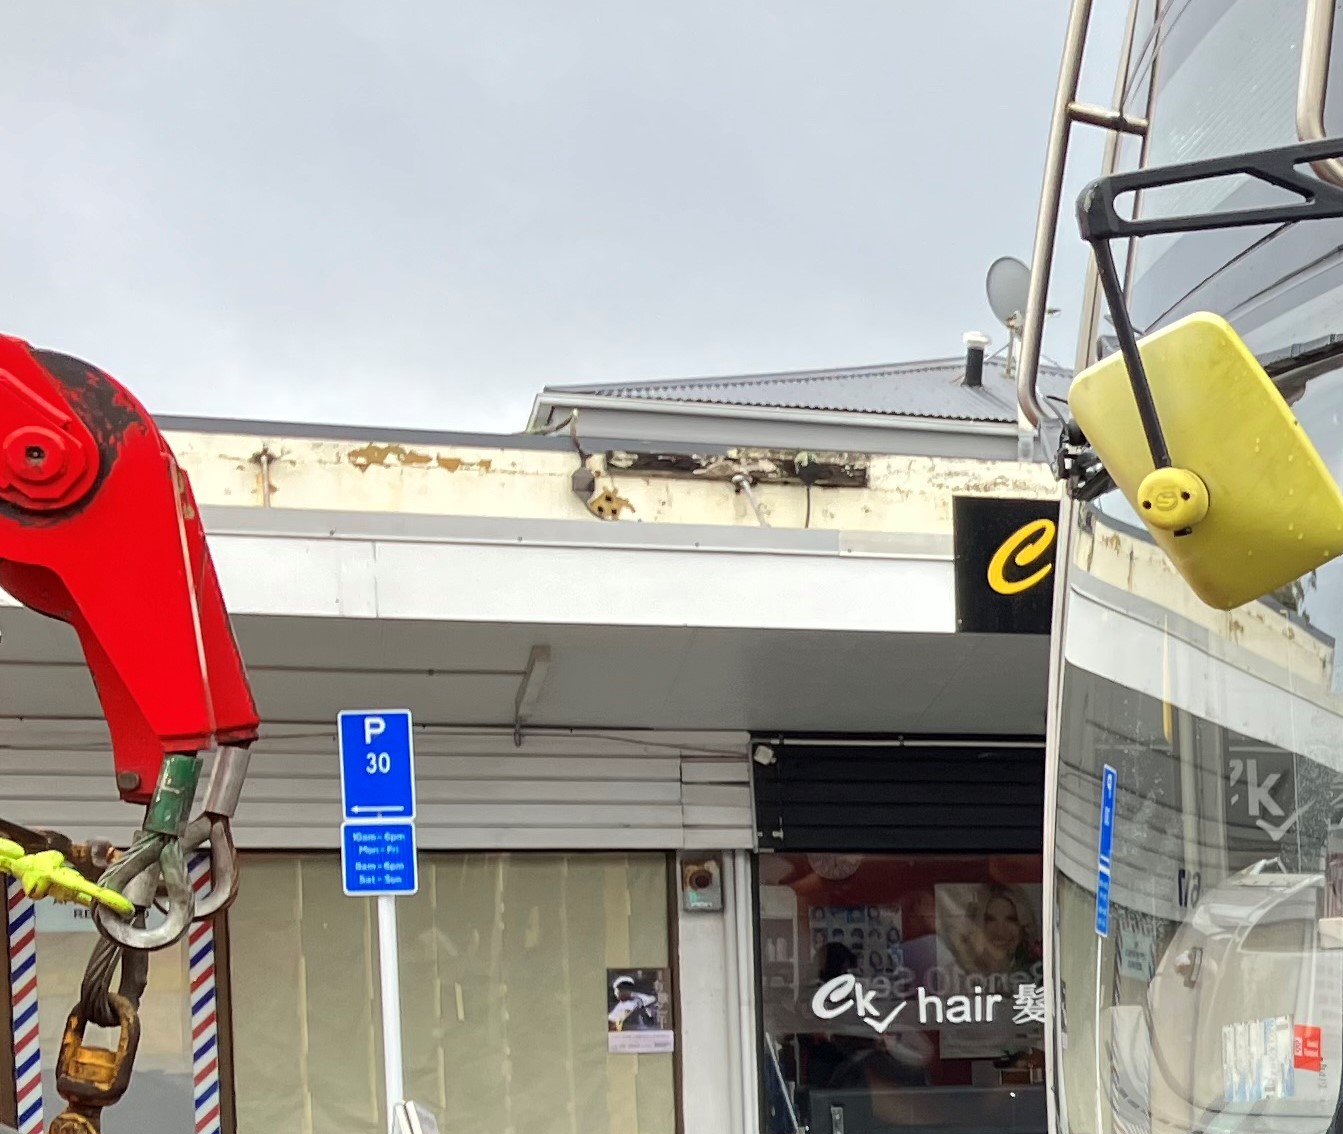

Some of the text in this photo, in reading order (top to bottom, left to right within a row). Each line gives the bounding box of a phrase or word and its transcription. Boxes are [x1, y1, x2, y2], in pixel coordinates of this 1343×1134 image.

[364, 716, 386, 744] P
[366, 752, 391, 774] 30
[358, 846, 379, 854] Mon
[386, 845, 399, 854] Fri
[917, 986, 1002, 1024] hair
